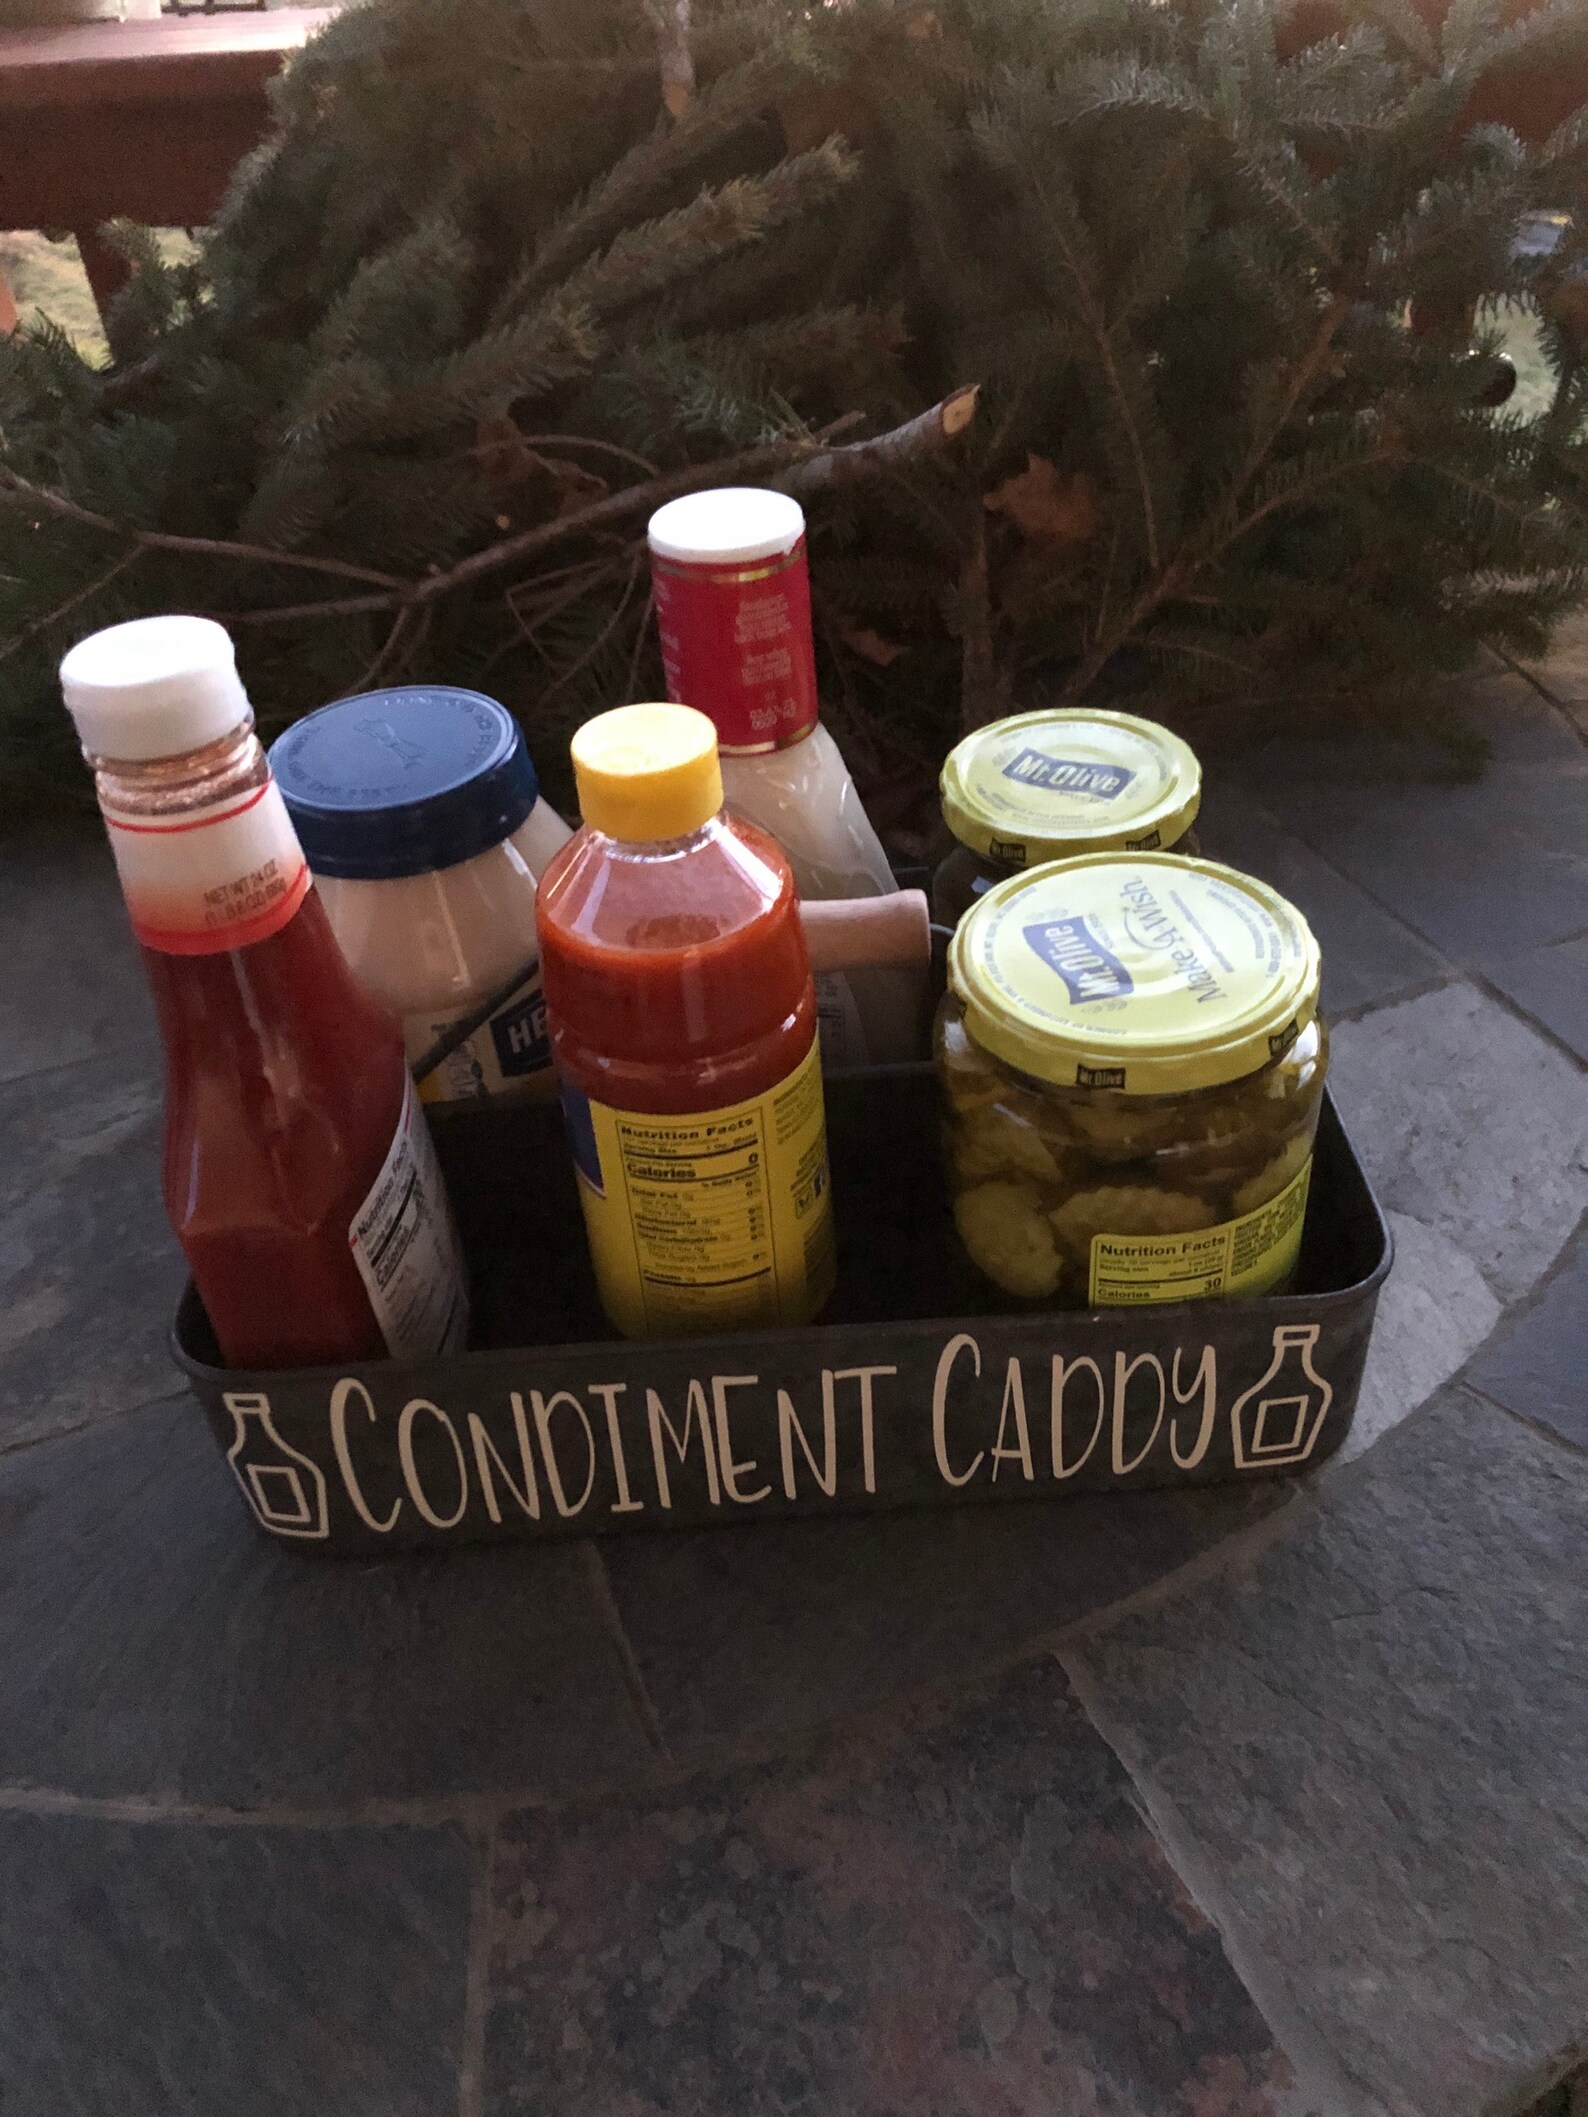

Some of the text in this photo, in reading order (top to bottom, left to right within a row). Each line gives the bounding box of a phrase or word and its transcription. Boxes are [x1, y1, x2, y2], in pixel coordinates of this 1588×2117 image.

[1049, 765, 1122, 793] Olive
[1044, 925, 1105, 971] Olive
[1171, 949, 1228, 1003] Make
[621, 1118, 754, 1141] Nutrition Facts
[626, 1152, 759, 1178] Calories 0
[1100, 1236, 1226, 1257] Nutrition Facts
[1098, 1278, 1222, 1299] Calories 30
[330, 1333, 1217, 1534] CONDIMENT CADDY
